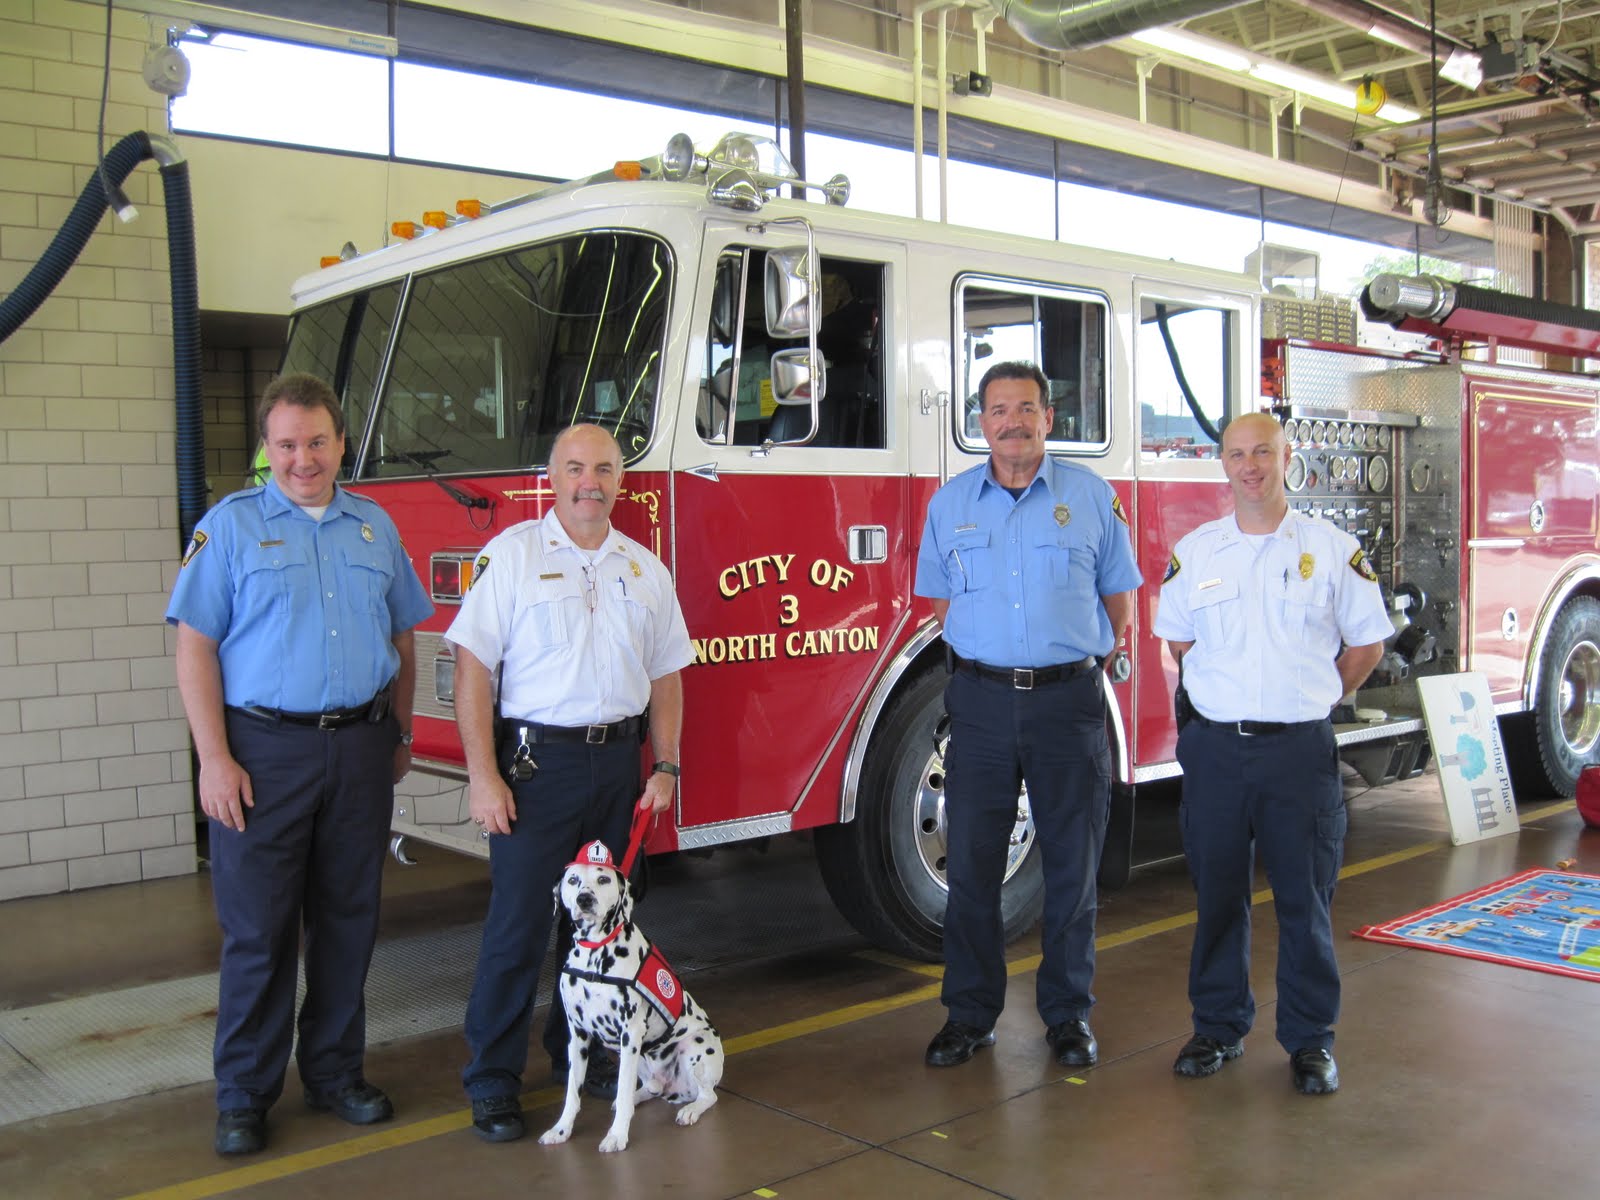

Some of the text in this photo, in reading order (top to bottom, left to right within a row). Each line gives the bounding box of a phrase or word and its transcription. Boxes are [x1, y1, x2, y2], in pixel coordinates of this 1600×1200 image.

[719, 554, 854, 599] CITY OF
[779, 595, 799, 625] 3
[691, 626, 879, 664] NORTH CANTON
[1500, 778, 1512, 814] Place
[594, 844, 600, 856] 1
